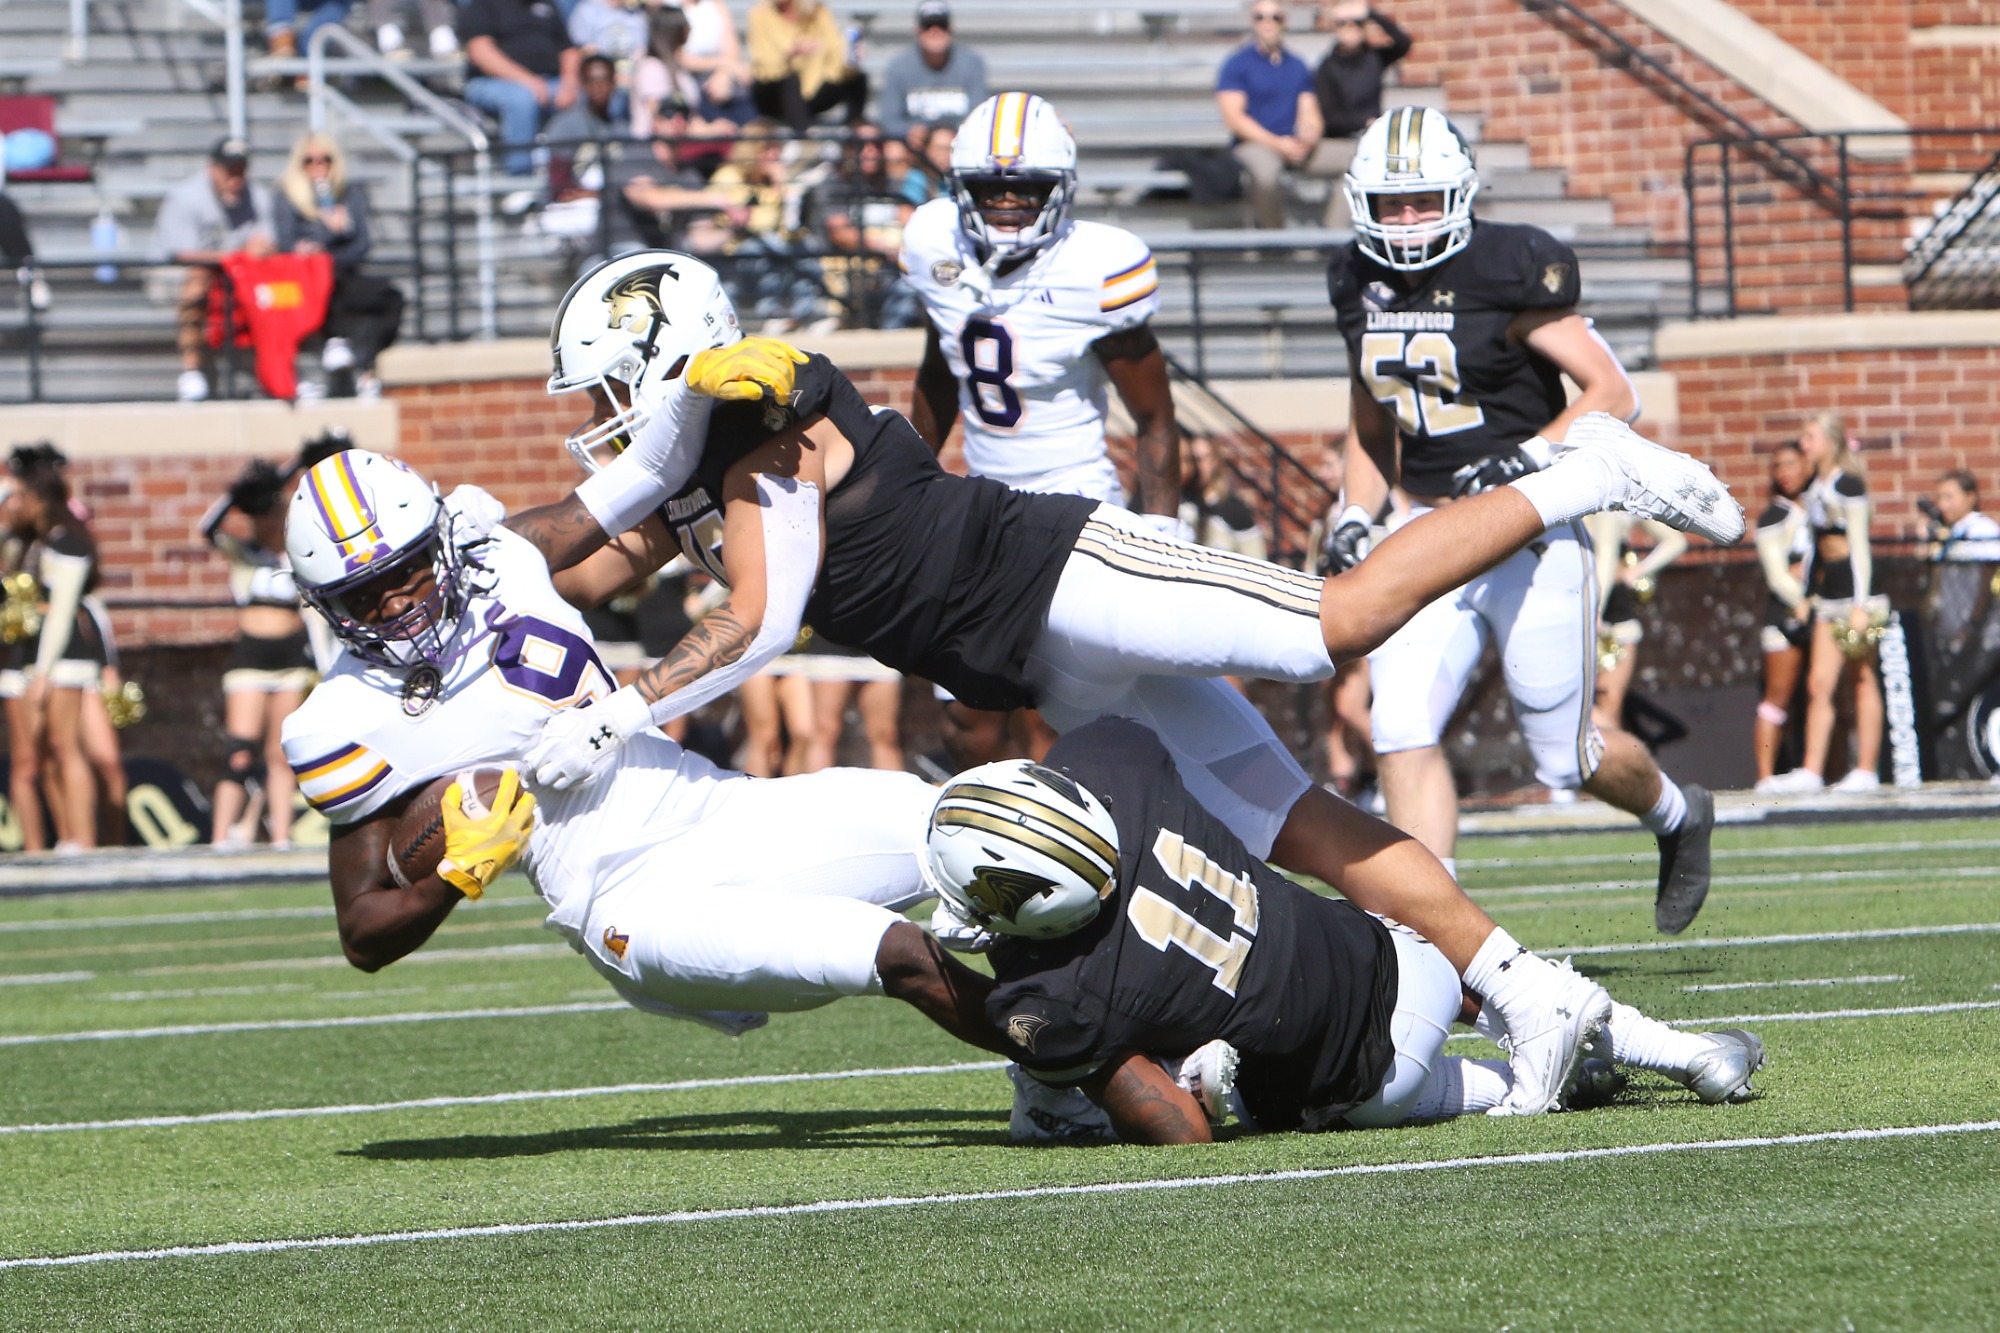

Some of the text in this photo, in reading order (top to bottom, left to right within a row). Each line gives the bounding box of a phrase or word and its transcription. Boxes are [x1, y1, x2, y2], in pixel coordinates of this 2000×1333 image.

[703, 312, 715, 327] 15
[1366, 311, 1455, 331] LINDENWOOD
[960, 314, 1026, 432] 8
[1360, 332, 1485, 437] 52
[490, 610, 620, 709] 9
[1879, 622, 1922, 789] TOUCHDOWN
[1127, 827, 1259, 999] 11
